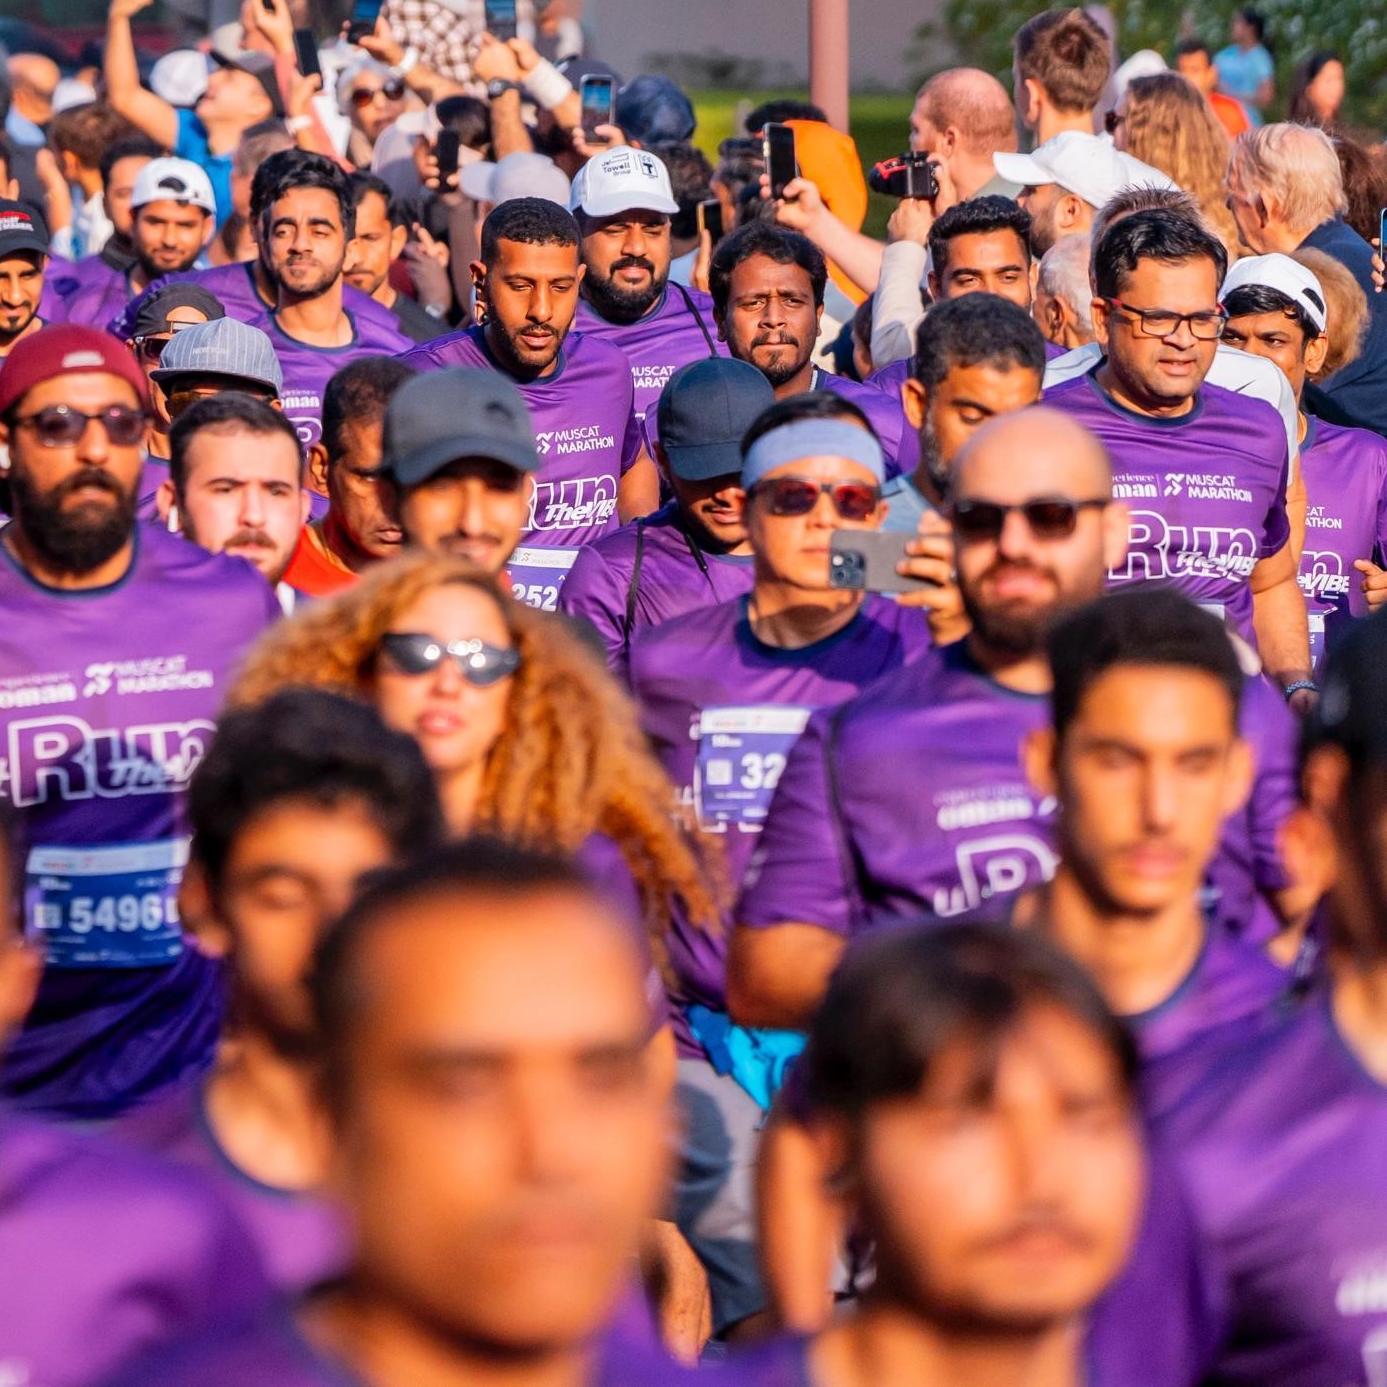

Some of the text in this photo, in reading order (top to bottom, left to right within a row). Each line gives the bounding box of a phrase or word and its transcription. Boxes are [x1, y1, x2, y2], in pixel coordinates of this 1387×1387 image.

[555, 425, 601, 442] MUSCAT
[557, 435, 615, 455] MARATHON
[1185, 474, 1236, 487] MUSCAT
[1112, 482, 1158, 498] man
[1188, 486, 1253, 502] MARATHON
[544, 488, 619, 524] TheVIB
[1305, 517, 1342, 529] ATHON
[114, 655, 188, 677] MUSCAT
[116, 671, 215, 695] MARATHON
[68, 892, 164, 934] 5496
